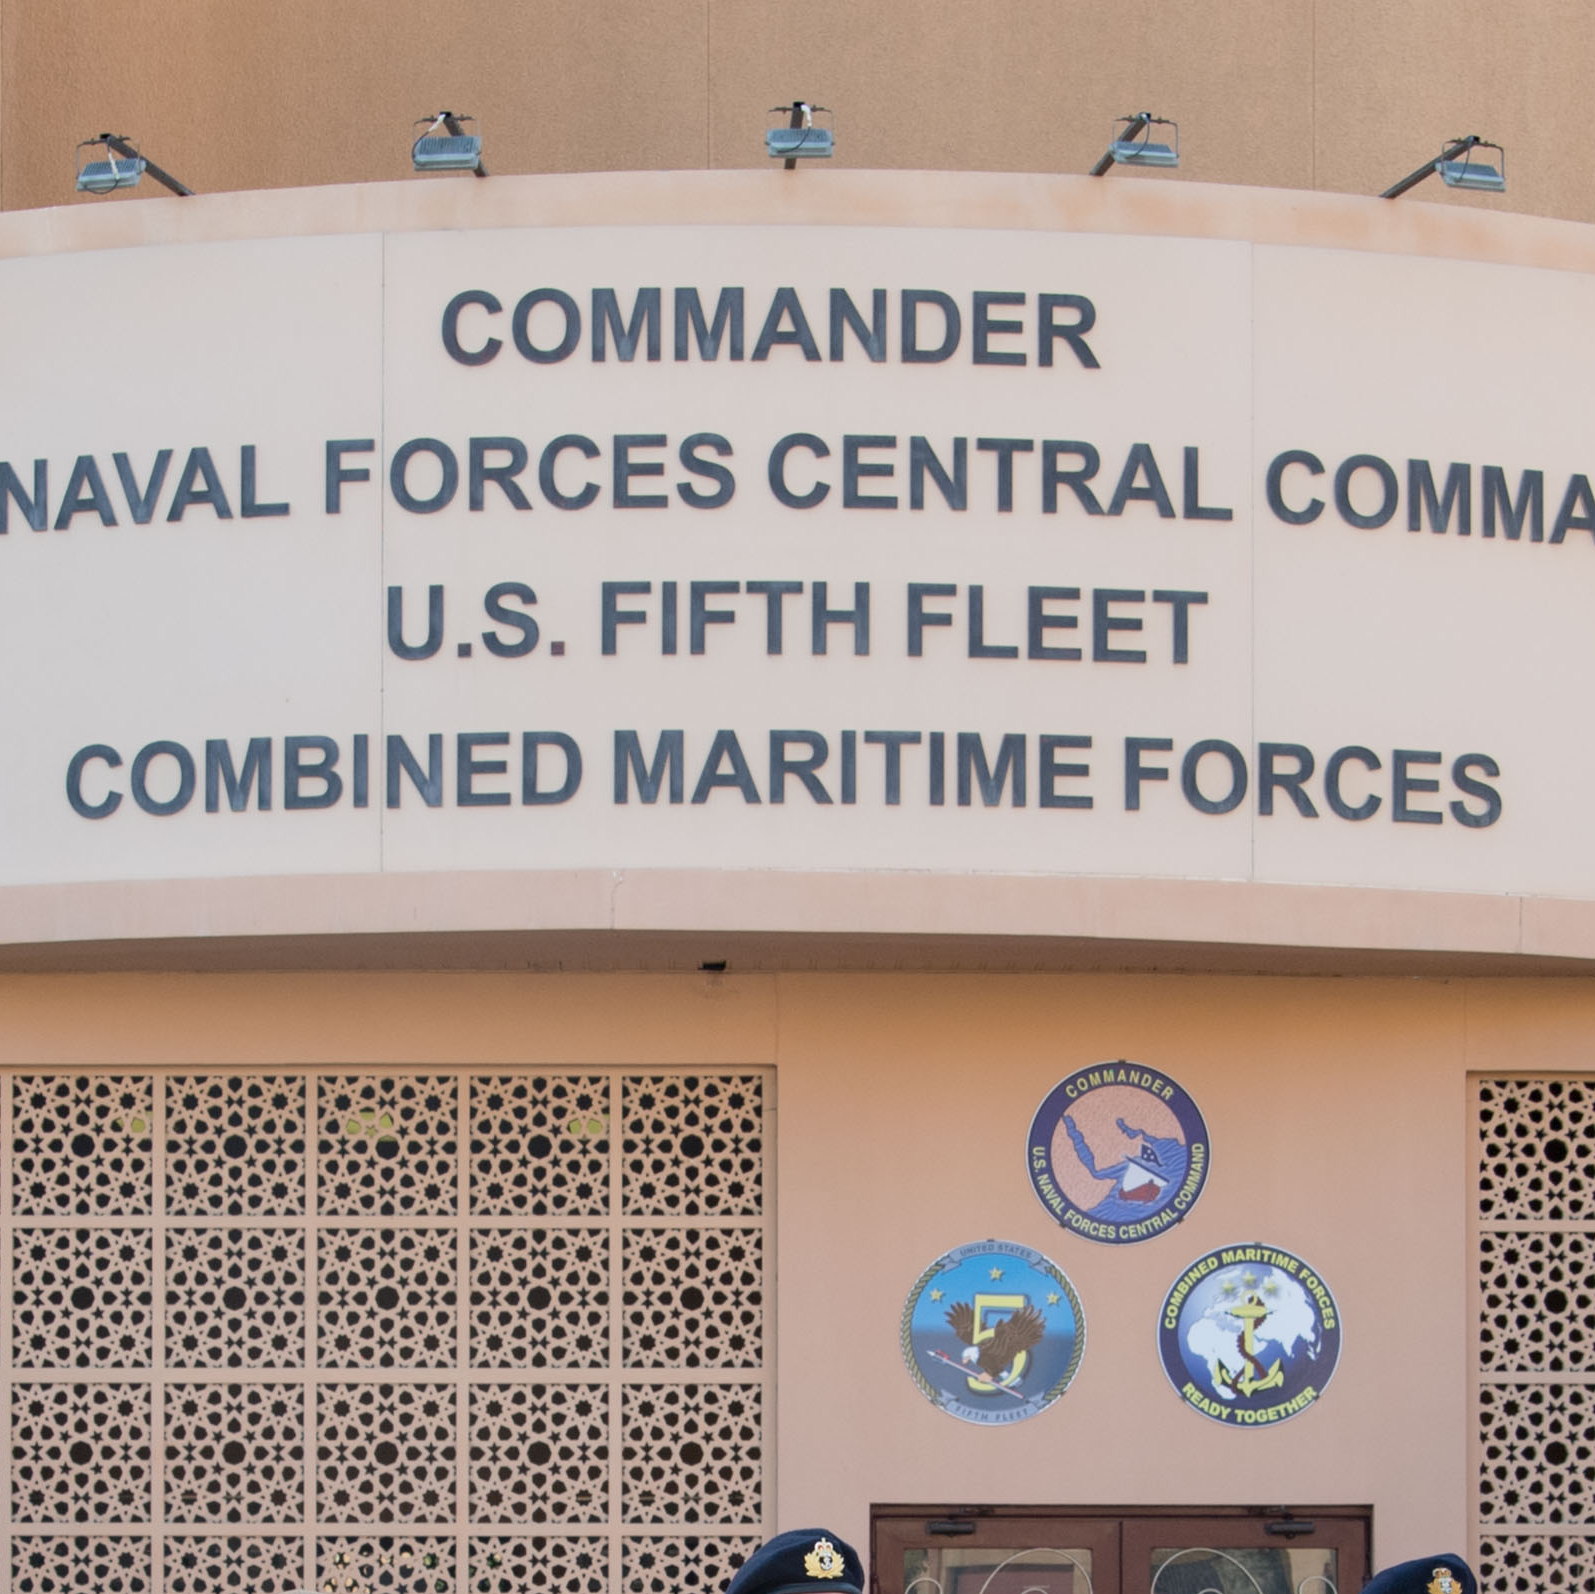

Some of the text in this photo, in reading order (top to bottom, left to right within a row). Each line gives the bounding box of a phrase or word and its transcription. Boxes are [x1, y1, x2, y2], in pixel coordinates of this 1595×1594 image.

[442, 287, 1100, 369] COMMANDER
[326, 433, 735, 514] FORCES
[768, 433, 1232, 521] CENTRAL
[388, 581, 1208, 664] U.S. FIFTH FLEET
[66, 730, 1502, 828] COMBINED MARITIME FORCES
[1065, 1069, 1174, 1100] COMMANDER
[1033, 1143, 1204, 1239] U.S. NAVAL FORCES CENTRAL COMMAND
[960, 1245, 1032, 1259] UNITED STATES
[1165, 1249, 1335, 1330] COMBINED MARITIME FORCES
[956, 1403, 1028, 1421] FIFTH FLEET
[1182, 1382, 1318, 1423] READY TOGETHER
